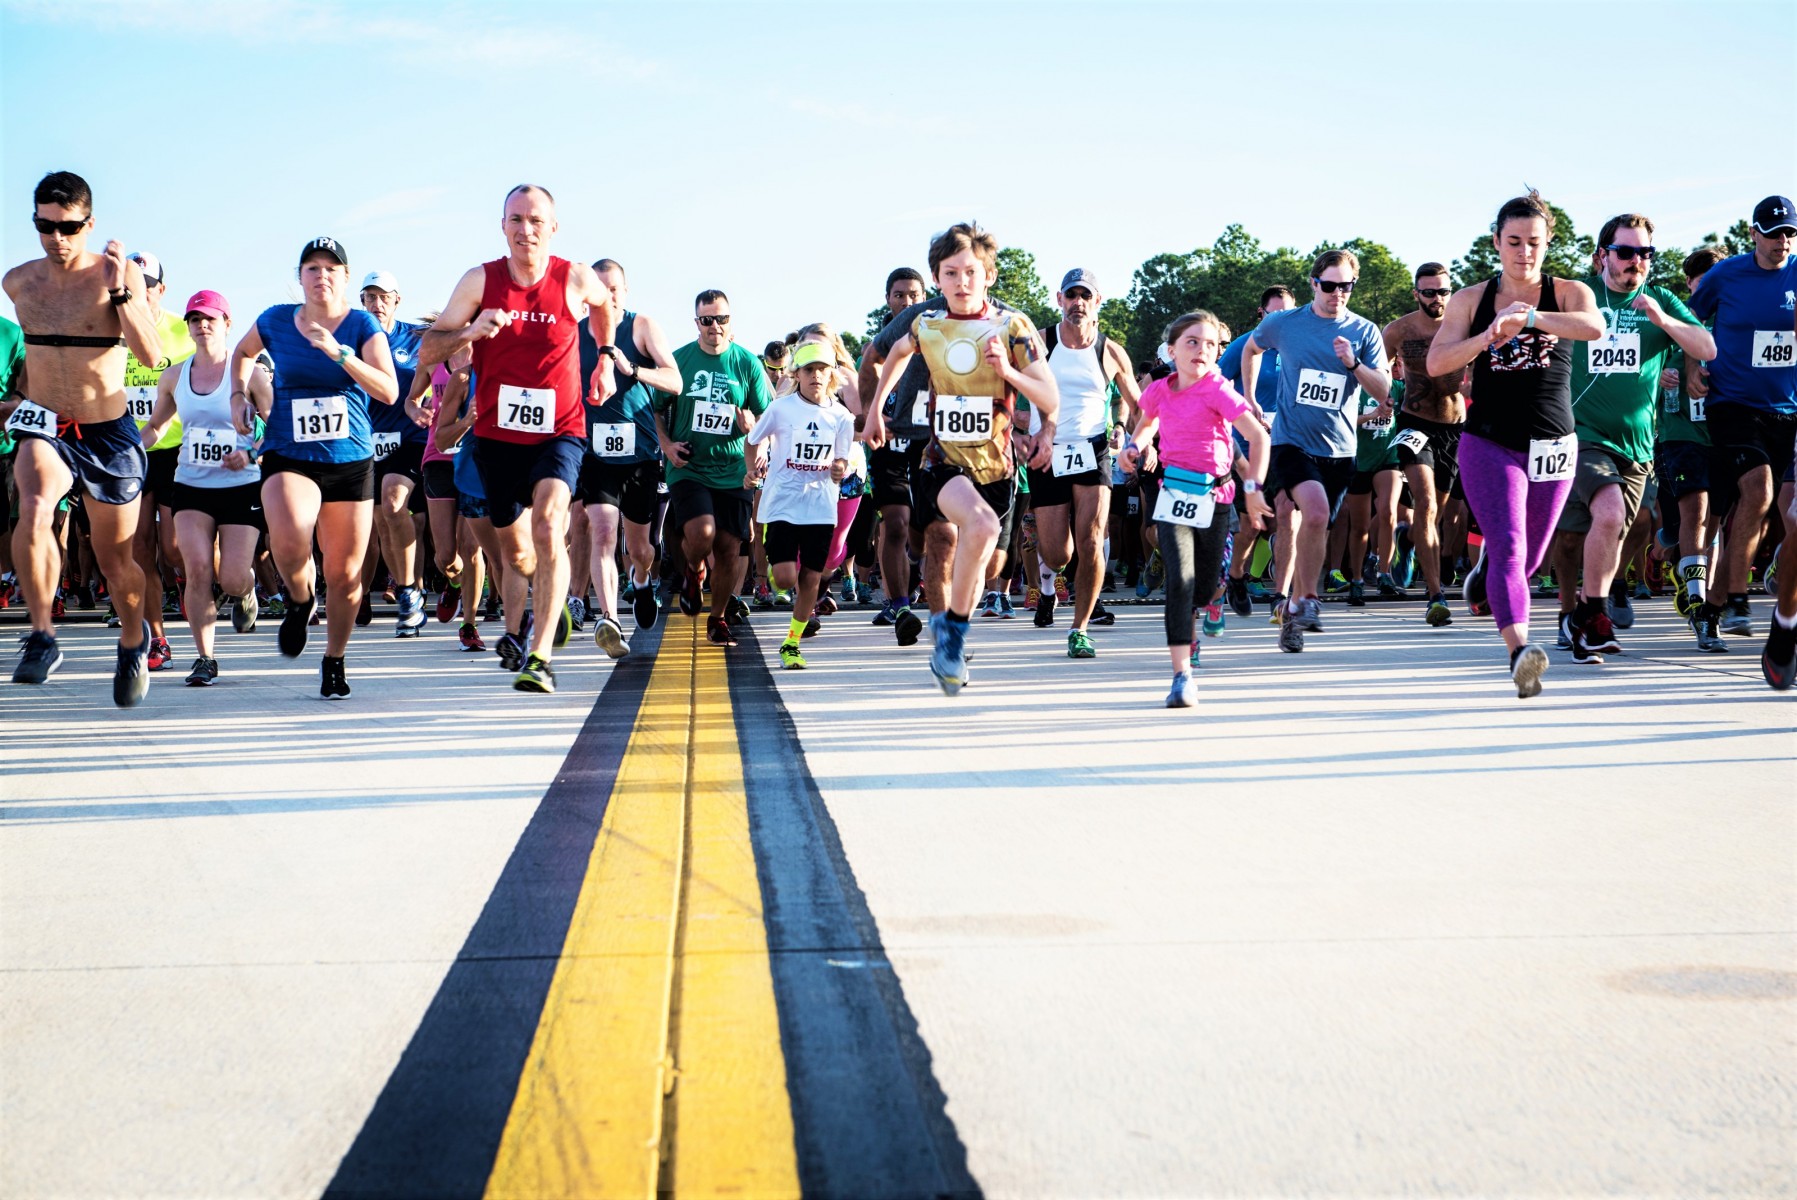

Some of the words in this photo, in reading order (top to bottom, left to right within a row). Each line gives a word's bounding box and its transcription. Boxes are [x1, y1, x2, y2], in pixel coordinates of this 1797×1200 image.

[511, 309, 557, 325] DELTA
[1592, 348, 1636, 367] 2043
[1761, 344, 1793, 362] 489
[132, 375, 158, 387] Childre
[711, 387, 730, 403] 5K
[1299, 382, 1339, 404] 2051
[127, 399, 154, 416] 181
[508, 403, 545, 426] 769
[10, 408, 47, 429] 684
[297, 413, 344, 435] 1317
[696, 413, 731, 430] 1574
[935, 410, 991, 434] 1805
[375, 441, 400, 457] 048
[605, 436, 624, 452] 98
[795, 442, 832, 460] 1577
[1063, 453, 1084, 470] 74
[1171, 500, 1198, 519] 68
